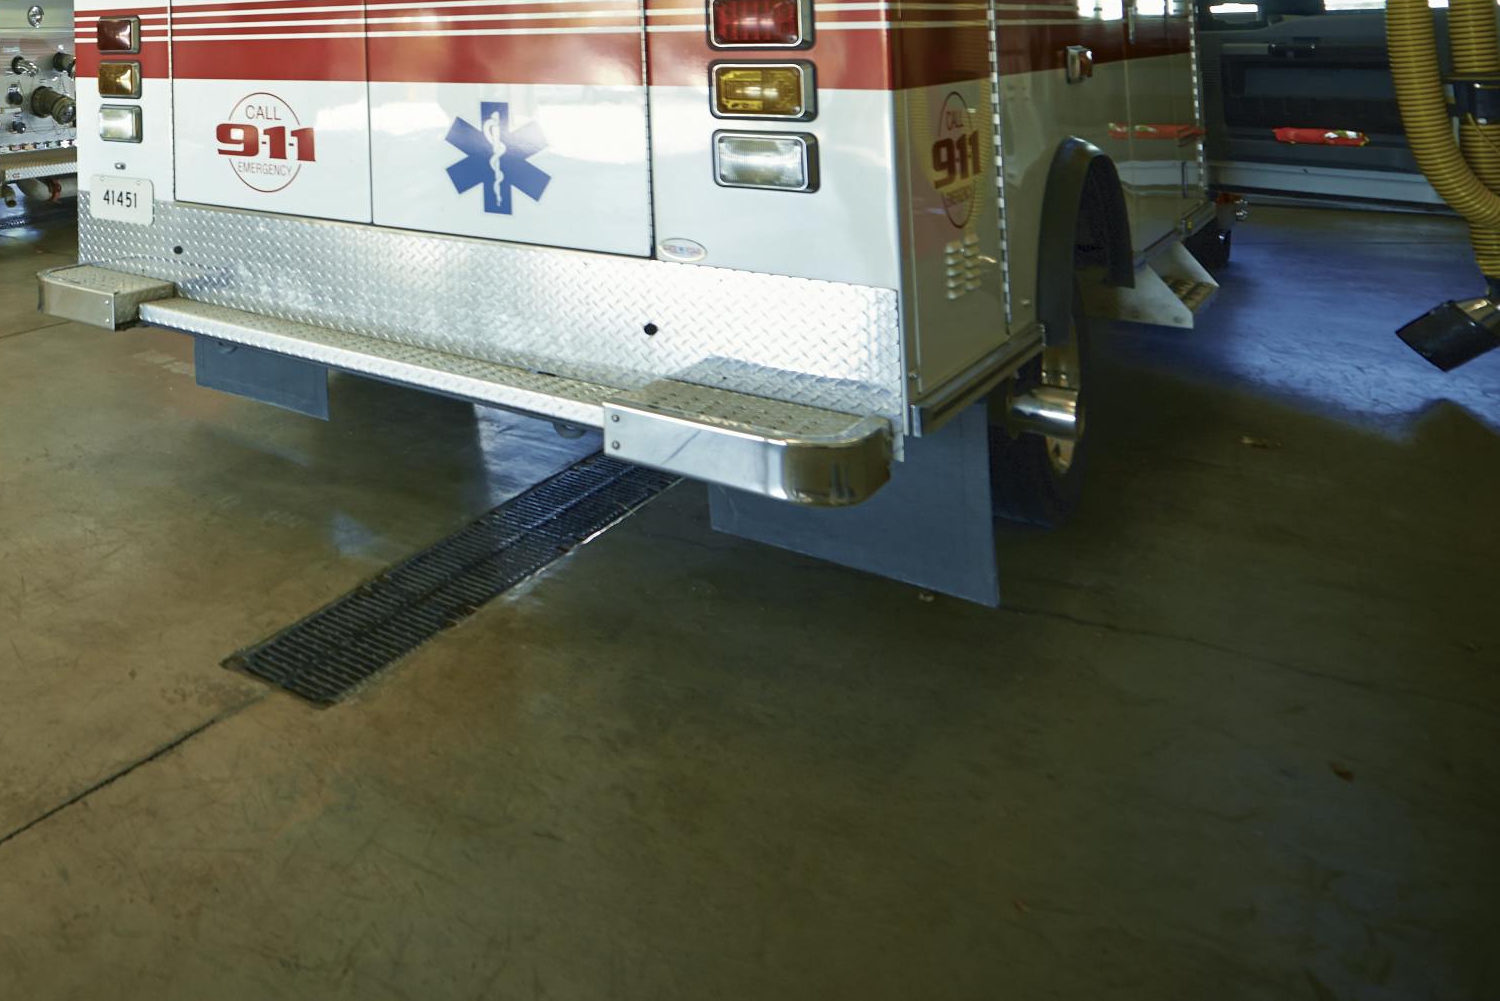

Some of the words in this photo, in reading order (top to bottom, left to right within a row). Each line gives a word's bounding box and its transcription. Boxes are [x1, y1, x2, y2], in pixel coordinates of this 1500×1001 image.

[245, 104, 282, 121] CALL
[238, 161, 293, 177] EMERGENCY
[103, 189, 137, 209] 41451
